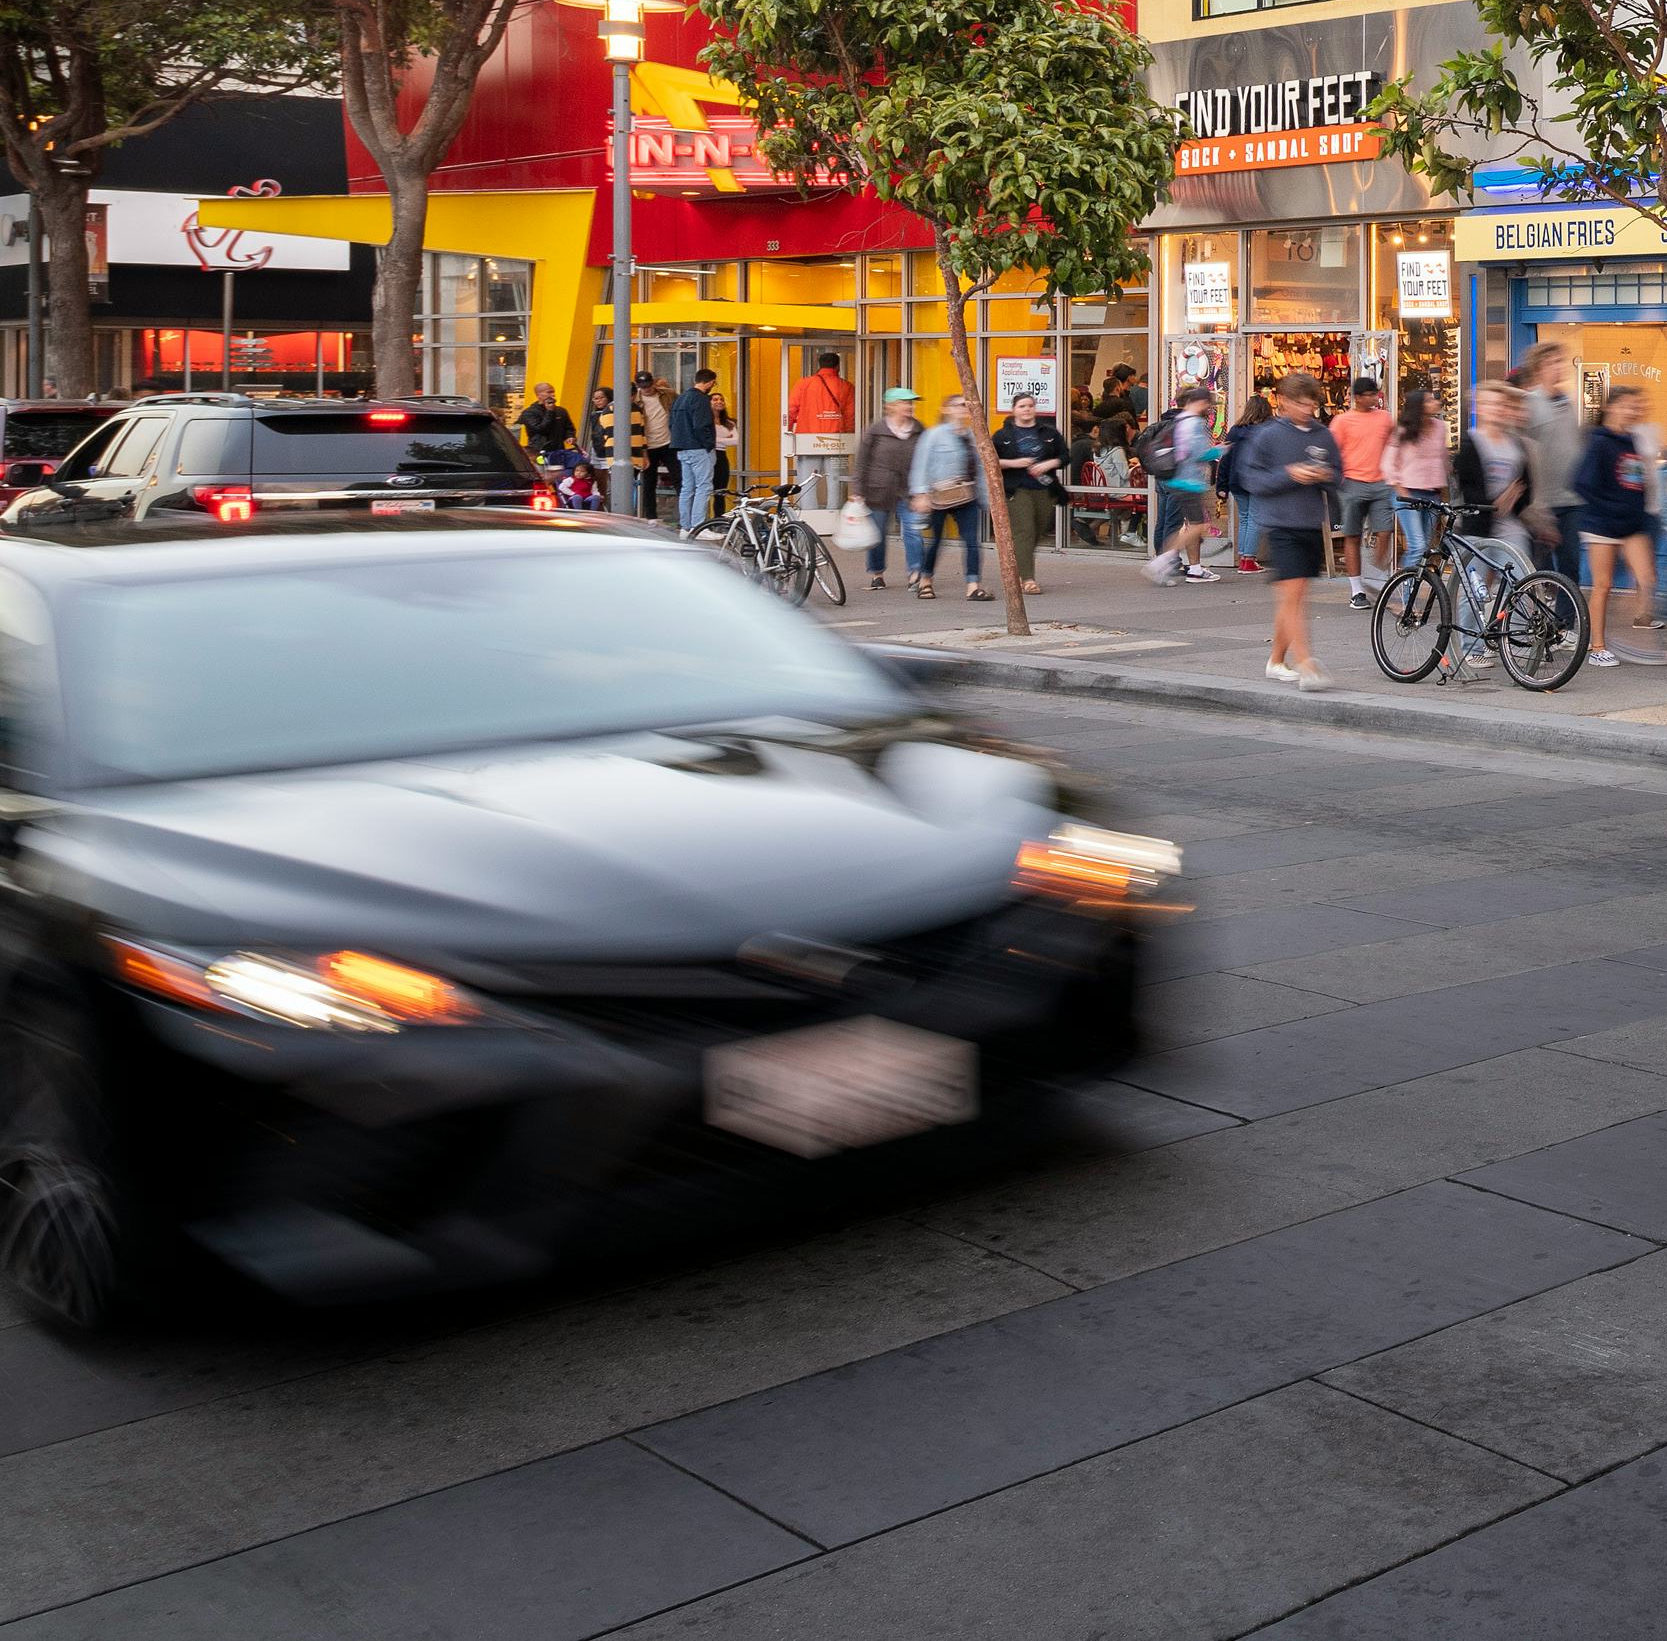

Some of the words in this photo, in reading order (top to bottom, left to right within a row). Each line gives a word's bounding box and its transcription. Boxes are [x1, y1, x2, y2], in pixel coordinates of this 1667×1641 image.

[1175, 89, 1231, 137] FIND
[1237, 79, 1300, 134] YOUR
[1308, 71, 1372, 128] FEET
[1181, 146, 1220, 169] SOCK
[1245, 138, 1309, 163] SANDAL
[1319, 131, 1363, 156] SHOP
[1496, 221, 1563, 250] BELGIAN
[1567, 219, 1615, 246] FRIES
[767, 240, 780, 251] 333
[1401, 262, 1421, 277] FIND
[1188, 272, 1205, 286] FIND
[1402, 280, 1425, 296] YOUR
[1427, 279, 1447, 296] FEET
[1189, 288, 1208, 304] YOUR
[1210, 287, 1228, 303] FEET
[1611, 361, 1638, 377] CRÊPE
